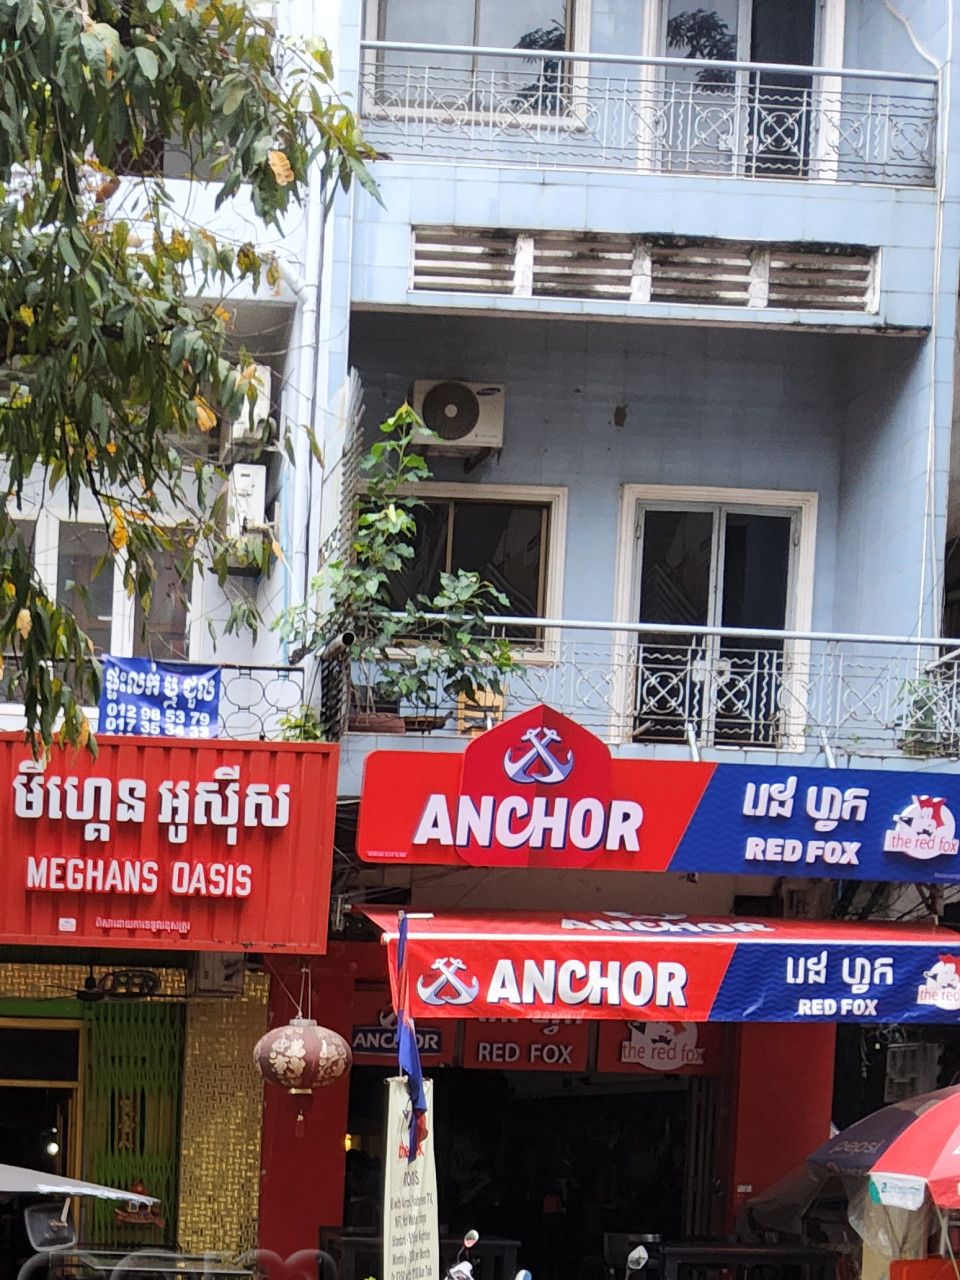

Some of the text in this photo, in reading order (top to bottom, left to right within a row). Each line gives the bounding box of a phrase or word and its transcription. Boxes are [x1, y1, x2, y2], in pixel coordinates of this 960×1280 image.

[106, 703, 210, 725] 012 98 53 79
[105, 717, 137, 731] 017
[140, 721, 161, 734] 35
[165, 724, 185, 737] 34
[12, 759, 291, 846] មីហ្គេន អូស៊ីស
[413, 793, 645, 853] ANCHOR
[745, 836, 862, 866] RED FOX
[891, 833, 957, 854] the red fox
[27, 857, 253, 897] MEGHANS OASIS
[560, 917, 779, 933] ANCHOR
[486, 958, 688, 1007] ANCHOR
[920, 986, 939, 1001] the
[798, 998, 879, 1016] RED FOX
[478, 1043, 573, 1064] RED FOX
[621, 1041, 706, 1064] the red fox
[828, 1139, 884, 1157] pepsi
